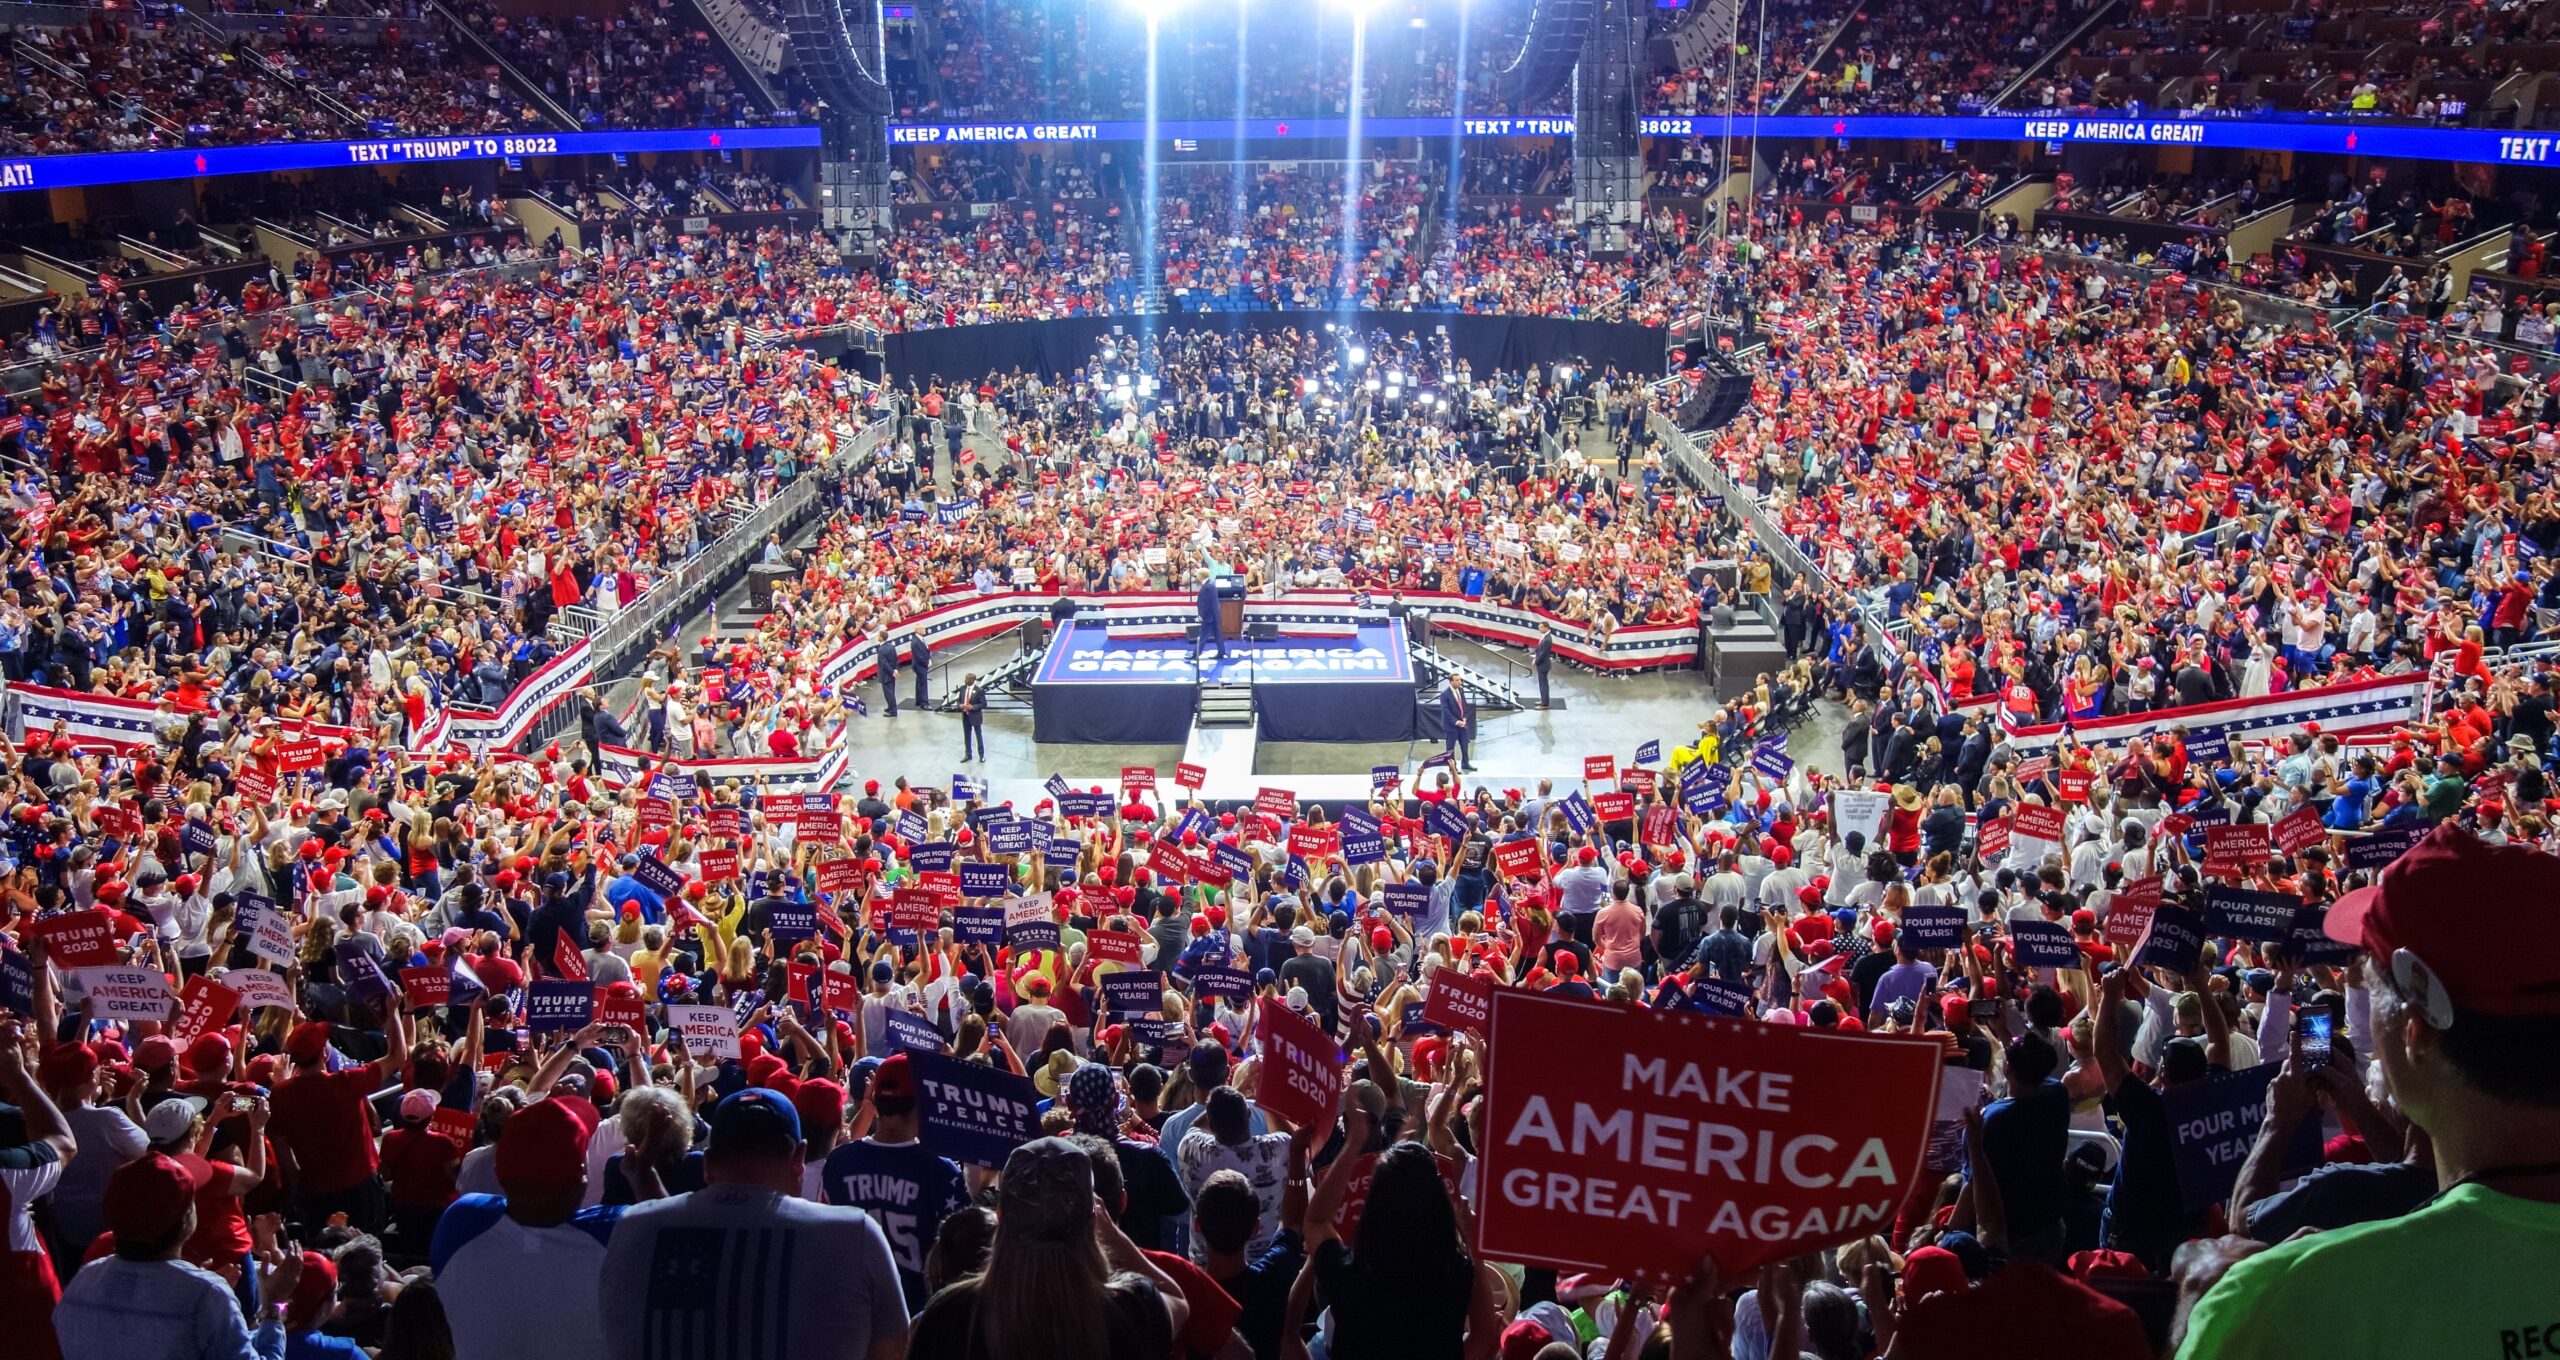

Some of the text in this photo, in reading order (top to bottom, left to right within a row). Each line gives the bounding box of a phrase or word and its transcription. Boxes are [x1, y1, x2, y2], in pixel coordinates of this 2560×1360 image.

[894, 125, 1097, 142] KEEP AMERICA GREAT!
[1464, 120, 1511, 134] TEXT
[2025, 122, 2204, 142] KEEP AMERICA GREAT!
[350, 138, 557, 161] TEXT "TRUMP" TO 88022
[2501, 138, 2550, 161] TEXT
[1072, 650, 1196, 659] MAKE
[1068, 659, 1388, 671] GREAT AGAIN!
[2205, 738, 2225, 747] MORE
[281, 747, 319, 757] TRUMP
[2194, 748, 2219, 756] YEARS!
[1179, 768, 1204, 778] TRUMP
[239, 775, 272, 794] AMERICA
[1259, 796, 1292, 805] AMERICA
[1688, 788, 1720, 803] FOUR MORE
[1695, 796, 1715, 807] YEARS!
[1438, 804, 1454, 819] FOUR
[2032, 809, 2050, 818] MAKE
[909, 815, 921, 824] KEEP
[1344, 813, 1379, 831] FOUR MORE
[1440, 815, 1461, 833] YEARS!
[2018, 813, 2060, 829] AMERICA
[2284, 818, 2302, 829] MAKE
[900, 819, 927, 834] AMERICA
[1349, 823, 1370, 833] YEARS!
[1985, 824, 1998, 833] MAKE
[2017, 822, 2036, 832] GREAT
[2279, 819, 2319, 843] AMERICA
[192, 827, 215, 841] TRUMP
[902, 827, 921, 840] GREAT!
[991, 834, 1030, 842] AMERICA
[1292, 834, 1326, 843] TRUMP
[2299, 828, 2323, 841] AGAIN
[998, 841, 1026, 849] GREAT!
[1346, 841, 1381, 850] TRUMP
[2212, 839, 2267, 850] AMERICA
[2350, 842, 2406, 853] FOUR MORE
[1217, 850, 1251, 869] FOUR MORE
[1499, 847, 1535, 861] TRUMP
[2363, 851, 2397, 859] YEARS!
[1160, 859, 1180, 872] 2020
[1222, 860, 1243, 873] YEARS!
[1508, 857, 1528, 866] 2020
[644, 862, 678, 888] TRUMP
[820, 870, 861, 881] AMERICA
[1200, 864, 1221, 877] 2020
[821, 880, 840, 888] GREAT
[896, 904, 938, 915] AMERICA
[1018, 900, 1039, 909] KEEP
[2211, 900, 2295, 916] FOUR MORE
[1009, 907, 1050, 921] AMERICA
[2226, 913, 2276, 926] YEARS!
[270, 918, 287, 933] KEEP
[1906, 918, 1933, 926] FOUR
[45, 927, 105, 944] TRUMP
[1013, 929, 1056, 938] TRUMP
[1917, 929, 1953, 937] YEARS!
[2017, 933, 2048, 942] FOUR
[2154, 922, 2199, 948] MORE
[63, 941, 99, 954] 2020
[259, 940, 290, 958] GREAT!
[1092, 937, 1135, 948] TRUMP
[1102, 945, 1126, 953] 2020
[2031, 945, 2071, 955] YEARS!
[4, 965, 27, 979] FOUR
[564, 955, 580, 976] 2020
[106, 974, 146, 983] KEEP
[1225, 975, 1251, 985] MORE
[93, 986, 172, 999] AMERICA
[1208, 982, 1240, 990] YEARS!
[1698, 983, 1749, 1003] FOUR MORE
[108, 1001, 164, 1013] GREAT!
[533, 996, 588, 1005] TRUMP
[1706, 993, 1735, 1009] YEARS!
[1447, 1000, 1486, 1021] 2020
[690, 1013, 719, 1022] KEEP
[186, 1006, 213, 1044] 2020
[889, 1019, 945, 1043] FOUR MORE
[686, 1038, 728, 1049] GREAT!
[900, 1032, 935, 1050] YEARS!
[1272, 1033, 1337, 1091] TRUMP
[1287, 1068, 1326, 1109] 2020
[1621, 1053, 1793, 1112] MAKE
[922, 1079, 1029, 1118] TRUMP
[937, 1102, 1026, 1132] PENCE
[929, 1116, 1010, 1138] MAKE AMERICA GREAT
[2177, 1109, 2234, 1145] FOUR
[1505, 1095, 1898, 1189] AMERICA
[843, 1174, 919, 1206] TRUMP
[1502, 1168, 1891, 1241] GREAT AGAIN
